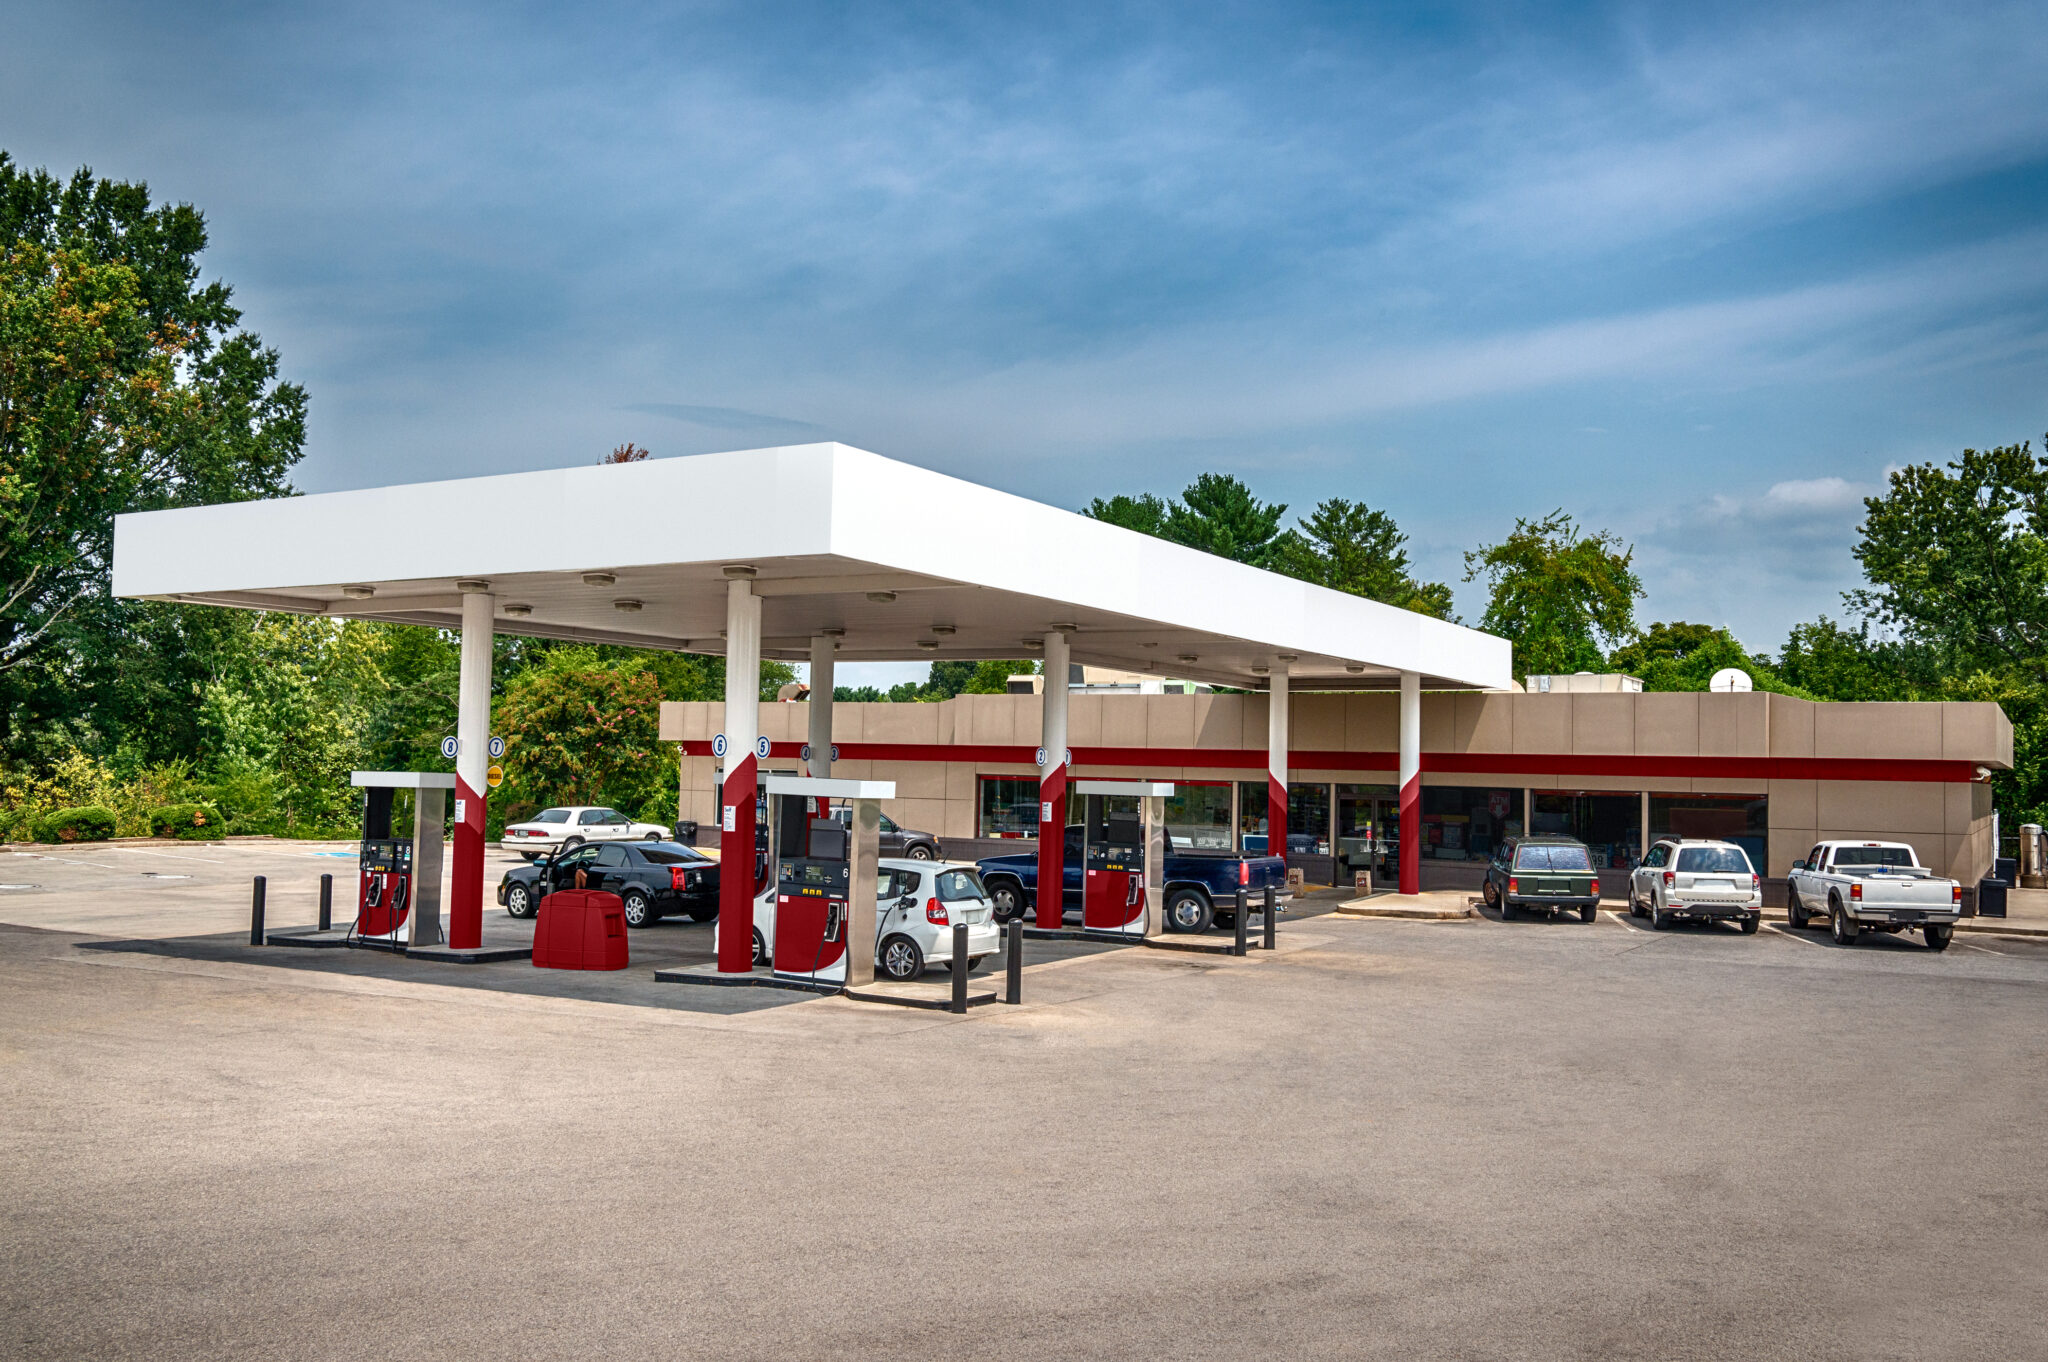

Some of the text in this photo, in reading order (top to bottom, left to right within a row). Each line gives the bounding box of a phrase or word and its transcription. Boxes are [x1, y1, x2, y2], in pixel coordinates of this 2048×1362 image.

[448, 741, 454, 753] 8
[494, 741, 500, 753] 7
[717, 739, 723, 752] 6
[760, 741, 766, 754] 5
[803, 748, 808, 757] 4
[832, 748, 836, 757] 3
[1039, 751, 1043, 761] 2
[406, 845, 411, 855] 8
[843, 867, 849, 878] 6
